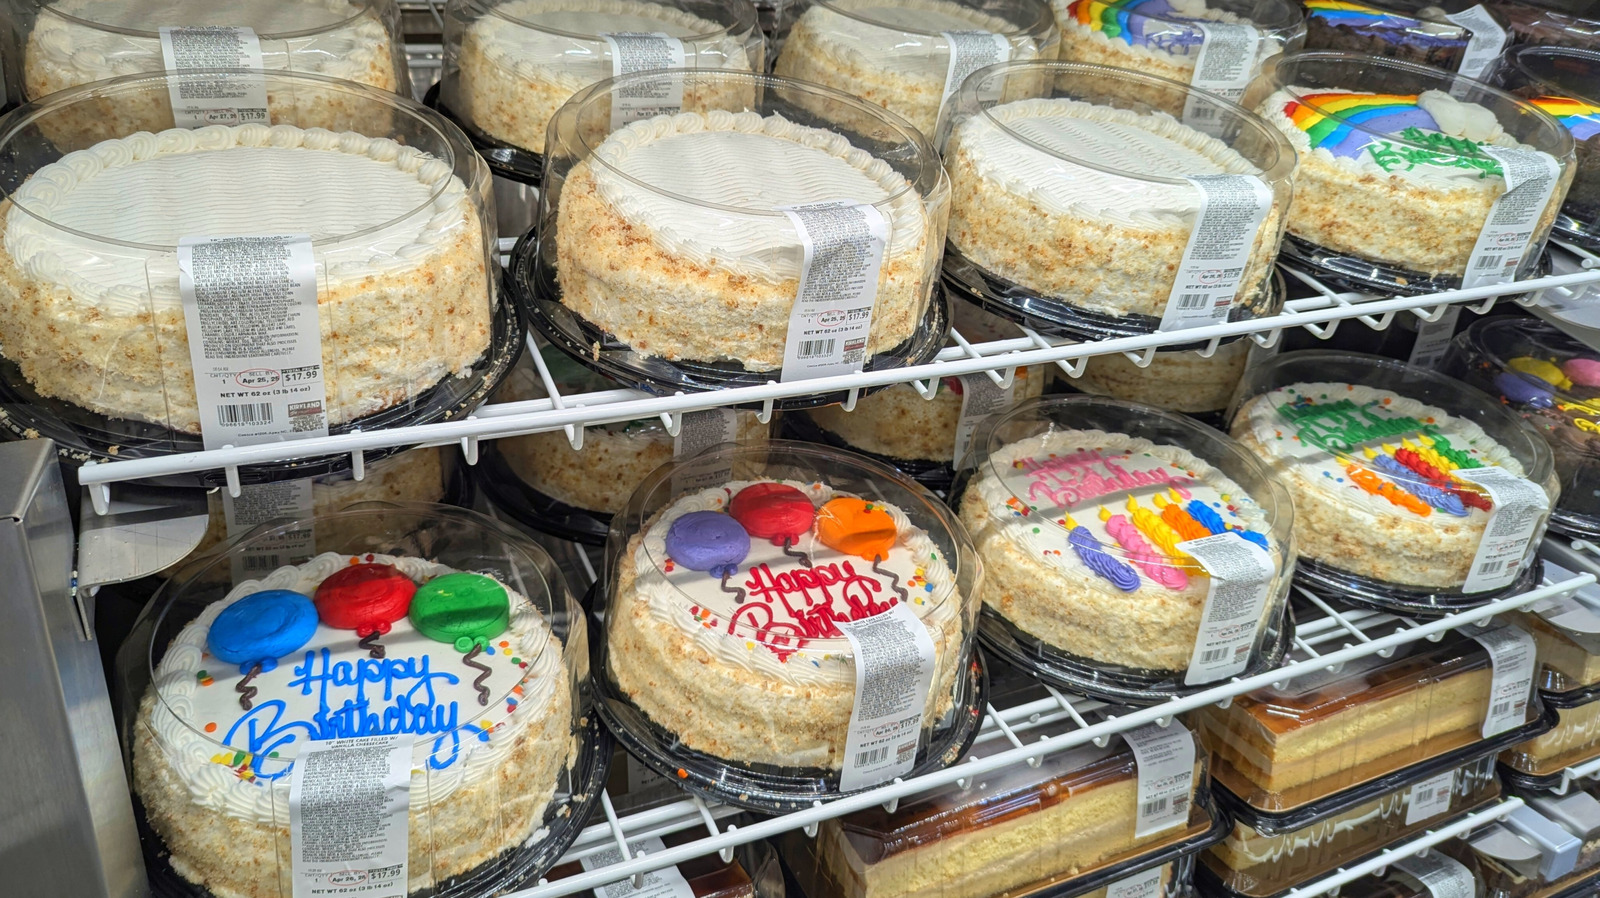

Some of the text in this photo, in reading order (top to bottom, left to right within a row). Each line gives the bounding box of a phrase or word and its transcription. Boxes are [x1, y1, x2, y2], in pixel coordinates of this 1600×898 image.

[240, 112, 266, 120] $17.99
[848, 311, 870, 321] $17.99
[286, 371, 318, 382] $17.99
[290, 401, 320, 411] KIRKLAND
[745, 560, 881, 618] Happy
[728, 594, 899, 662] Birthd
[289, 647, 459, 711] Happy
[222, 694, 489, 779] Birthday
[370, 869, 401, 880] $17.99
